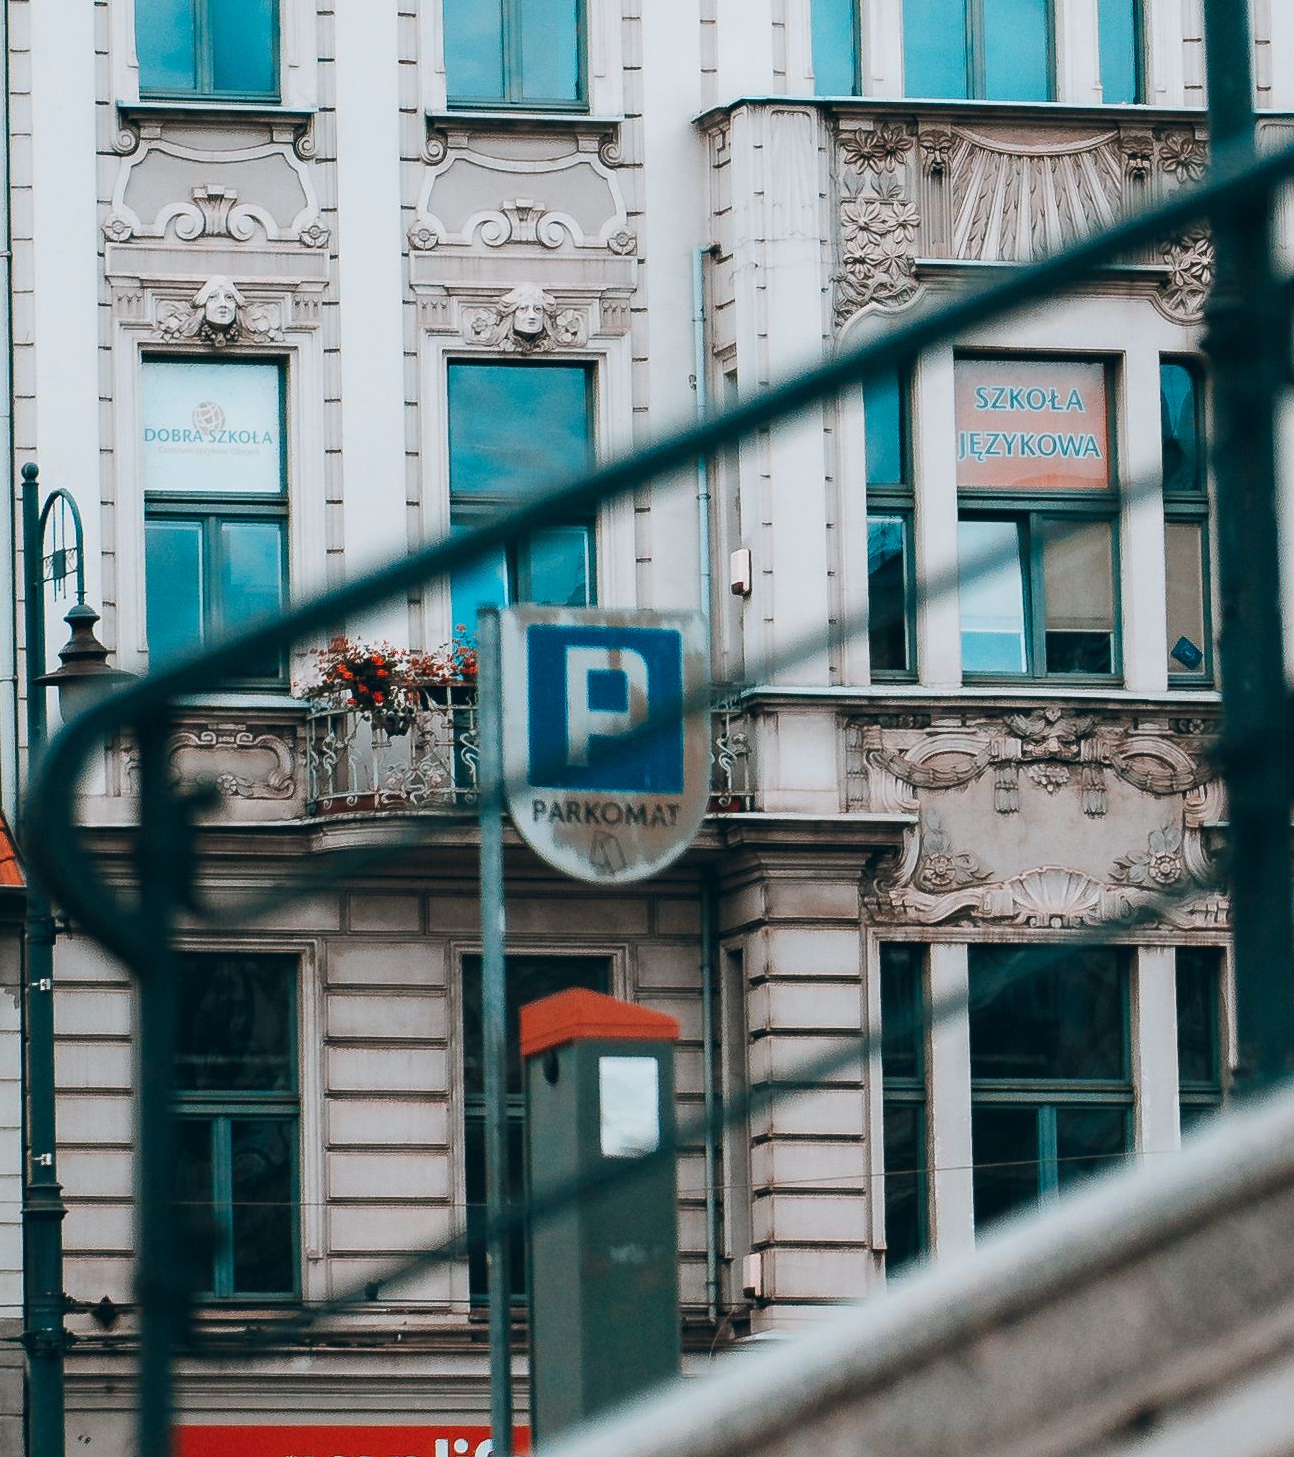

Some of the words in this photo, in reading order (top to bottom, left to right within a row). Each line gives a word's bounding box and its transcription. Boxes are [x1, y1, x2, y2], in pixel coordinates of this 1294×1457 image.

[975, 385, 1086, 413] SZKOŁA
[144, 428, 203, 443] DOBRA
[208, 429, 273, 445] SZKOŁA
[957, 431, 1103, 462] JĘZYKOWA
[565, 645, 650, 768] P
[531, 798, 681, 827] PARKOMAT
